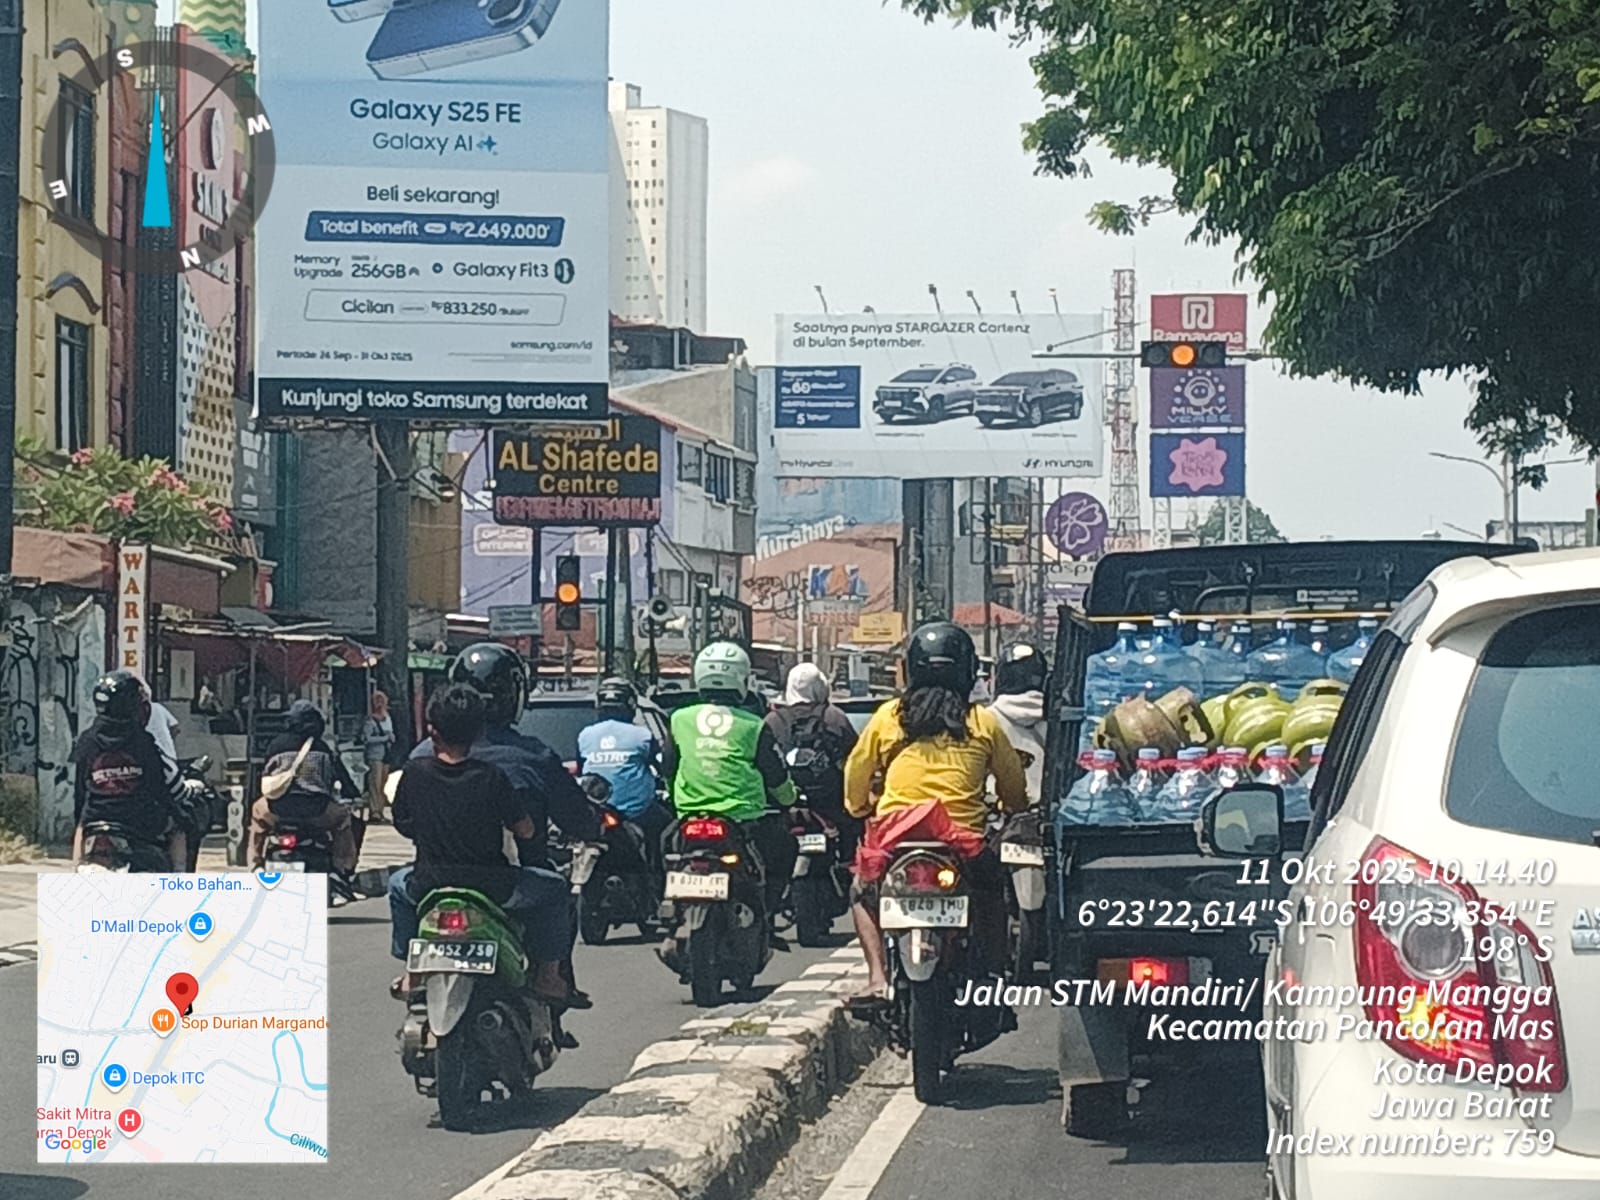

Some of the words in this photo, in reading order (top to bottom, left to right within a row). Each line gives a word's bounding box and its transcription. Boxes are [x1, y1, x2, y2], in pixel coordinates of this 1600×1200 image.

[350, 98, 443, 126] Galaxy
[448, 102, 490, 122] S25
[496, 103, 521, 123] FE
[373, 132, 448, 155] Galaxy
[454, 134, 473, 151] AI
[367, 186, 399, 202] Beli
[404, 187, 500, 209] sekarang!
[319, 220, 358, 235] Total
[361, 221, 419, 236] benefit
[294, 254, 341, 266] Memory
[294, 267, 343, 280] Upgrade
[351, 263, 407, 279] 256GB
[453, 261, 516, 281] Galaxy
[519, 262, 549, 278] Fit3
[342, 299, 394, 314] Cicilan
[793, 322, 849, 336] Saatnya
[851, 323, 893, 336] punya
[895, 322, 976, 334] STARGAZER
[510, 340, 593, 352] samsung.com/id
[793, 336, 805, 348] di
[808, 336, 846, 348] bulan
[849, 337, 925, 350] September.
[276, 350, 317, 359] Periode
[333, 350, 351, 362] Sep
[282, 388, 362, 410] Kunjungi
[366, 390, 409, 408] toko
[412, 391, 500, 414] Samsung
[506, 392, 588, 410] terdekat
[498, 441, 538, 471] AL
[542, 443, 659, 472] Shafeda
[539, 474, 619, 494] Centre
